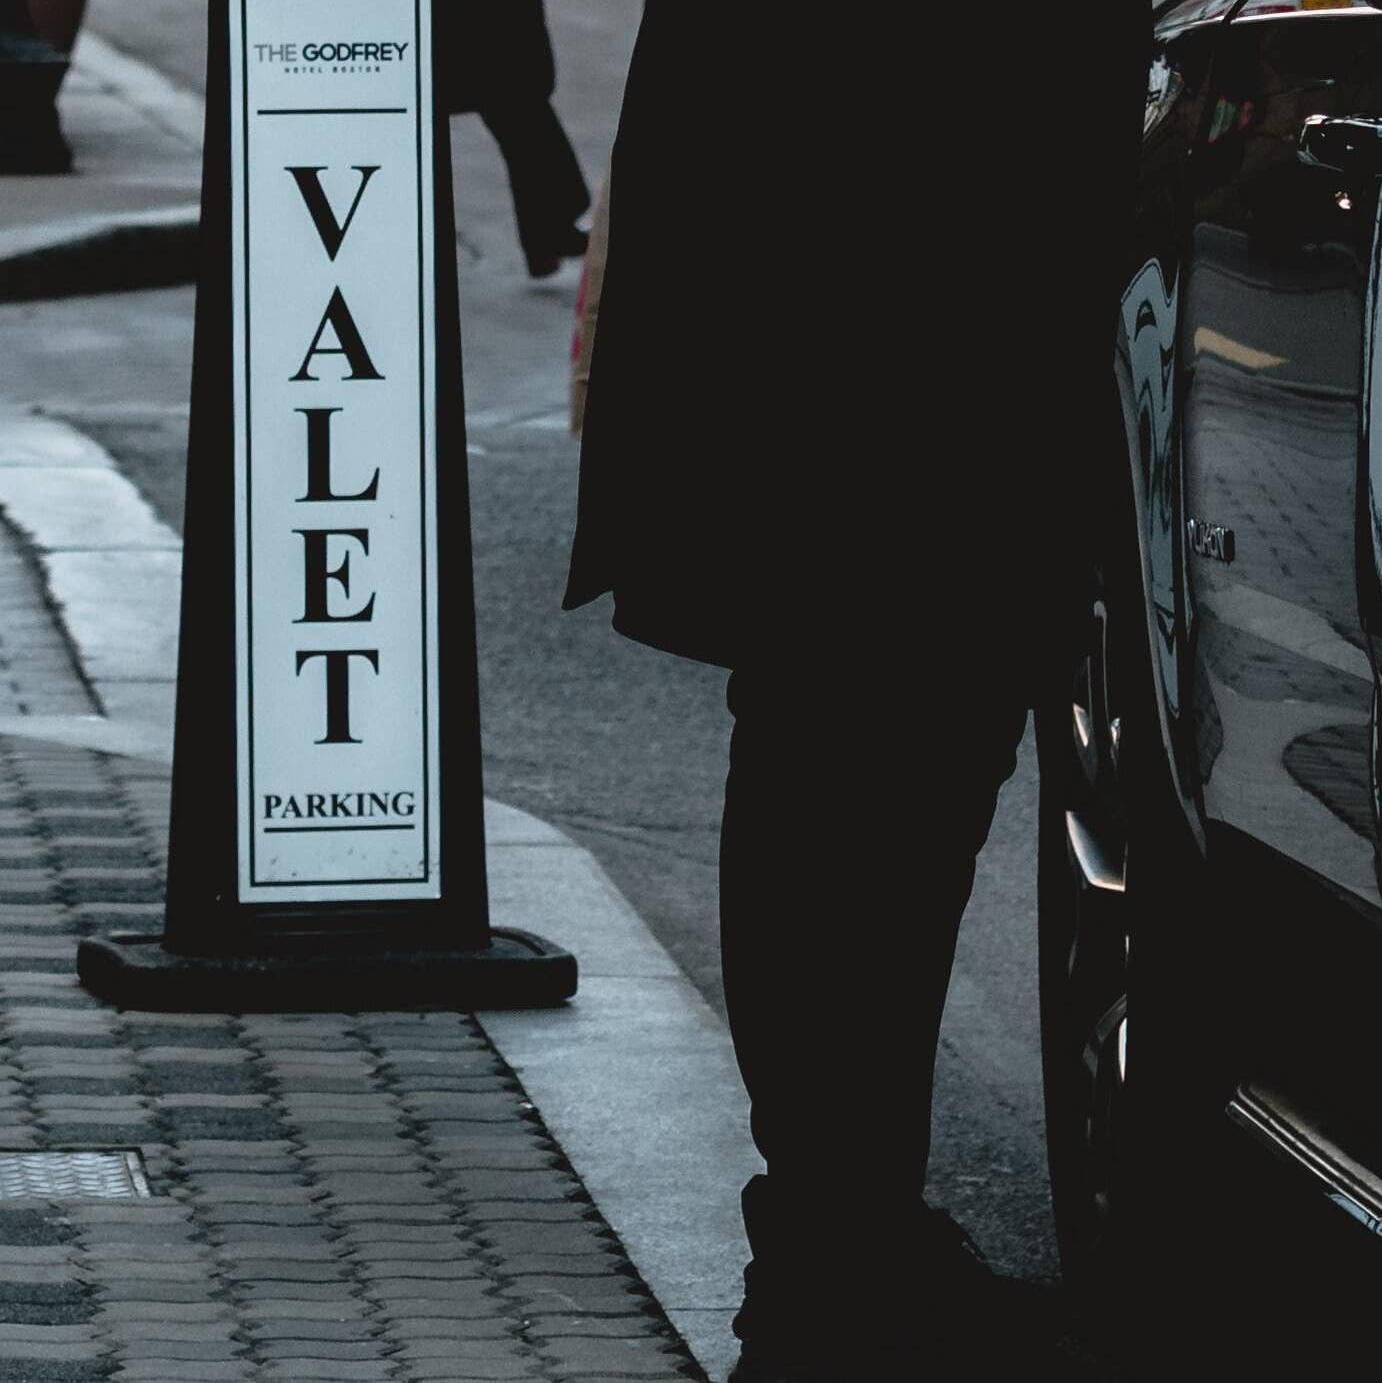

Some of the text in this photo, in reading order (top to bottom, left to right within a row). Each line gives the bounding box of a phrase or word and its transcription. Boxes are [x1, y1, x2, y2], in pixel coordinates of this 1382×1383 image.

[254, 42, 409, 62] THE GODFREY
[284, 66, 381, 74] HOTEL BOSTON
[285, 165, 386, 745] VALET
[263, 791, 416, 819] PARKING
